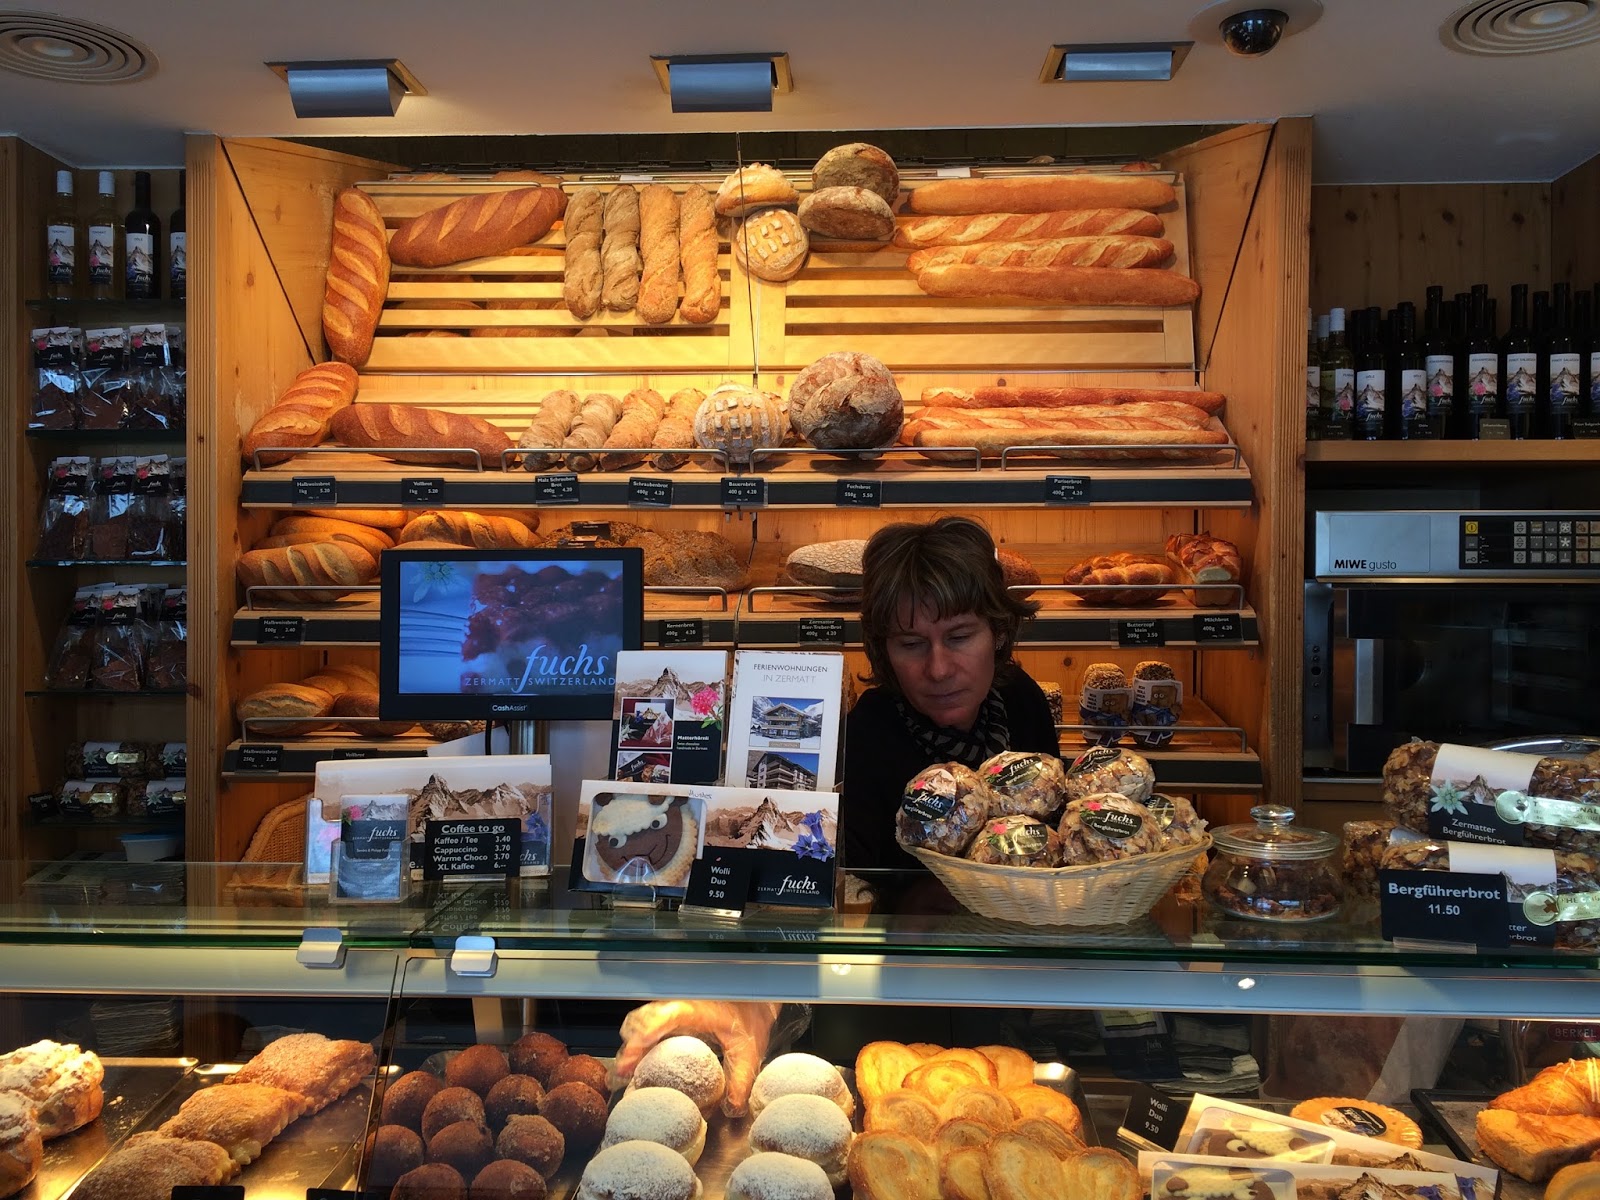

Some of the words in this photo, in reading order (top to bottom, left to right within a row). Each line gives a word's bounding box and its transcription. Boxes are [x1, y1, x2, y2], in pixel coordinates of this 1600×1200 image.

[1334, 559, 1367, 569] MIWE
[1368, 560, 1397, 572] gusto
[511, 643, 609, 694] fuchs
[753, 663, 828, 673] FERIENWOHNUNGEN
[465, 677, 520, 686] ZERMATT
[528, 677, 616, 686] SWITZERLAND
[775, 675, 816, 684] ZERMATT
[492, 704, 528, 712] CashAssist
[1009, 758, 1034, 777] fuchs
[1102, 811, 1135, 825] fuchs
[441, 824, 476, 834] Coffee
[478, 825, 489, 833] to
[492, 825, 505, 835] go
[1452, 818, 1497, 834] Zermatter
[367, 826, 398, 843] fuchs
[434, 837, 459, 845] Kaffee
[495, 835, 511, 843] 3.40
[1442, 826, 1507, 845] Bergführerbrot
[434, 847, 478, 855] Cappuccino
[520, 849, 538, 862] chs
[433, 855, 462, 863] Warme
[463, 853, 488, 861] Choco
[437, 863, 449, 871] XL
[451, 862, 475, 870] Kaffee
[710, 865, 731, 875] Wolli
[710, 876, 727, 886] Duo
[775, 874, 818, 896] fuchs
[708, 889, 725, 899] 9.50
[1388, 882, 1501, 900] Bergführerbrot
[1428, 903, 1461, 915] 11.50
[1555, 1028, 1597, 1038] BERKEL
[1150, 1097, 1168, 1112] Wolli
[1148, 1108, 1163, 1122] Duo
[1145, 1121, 1160, 1134] 9.50
